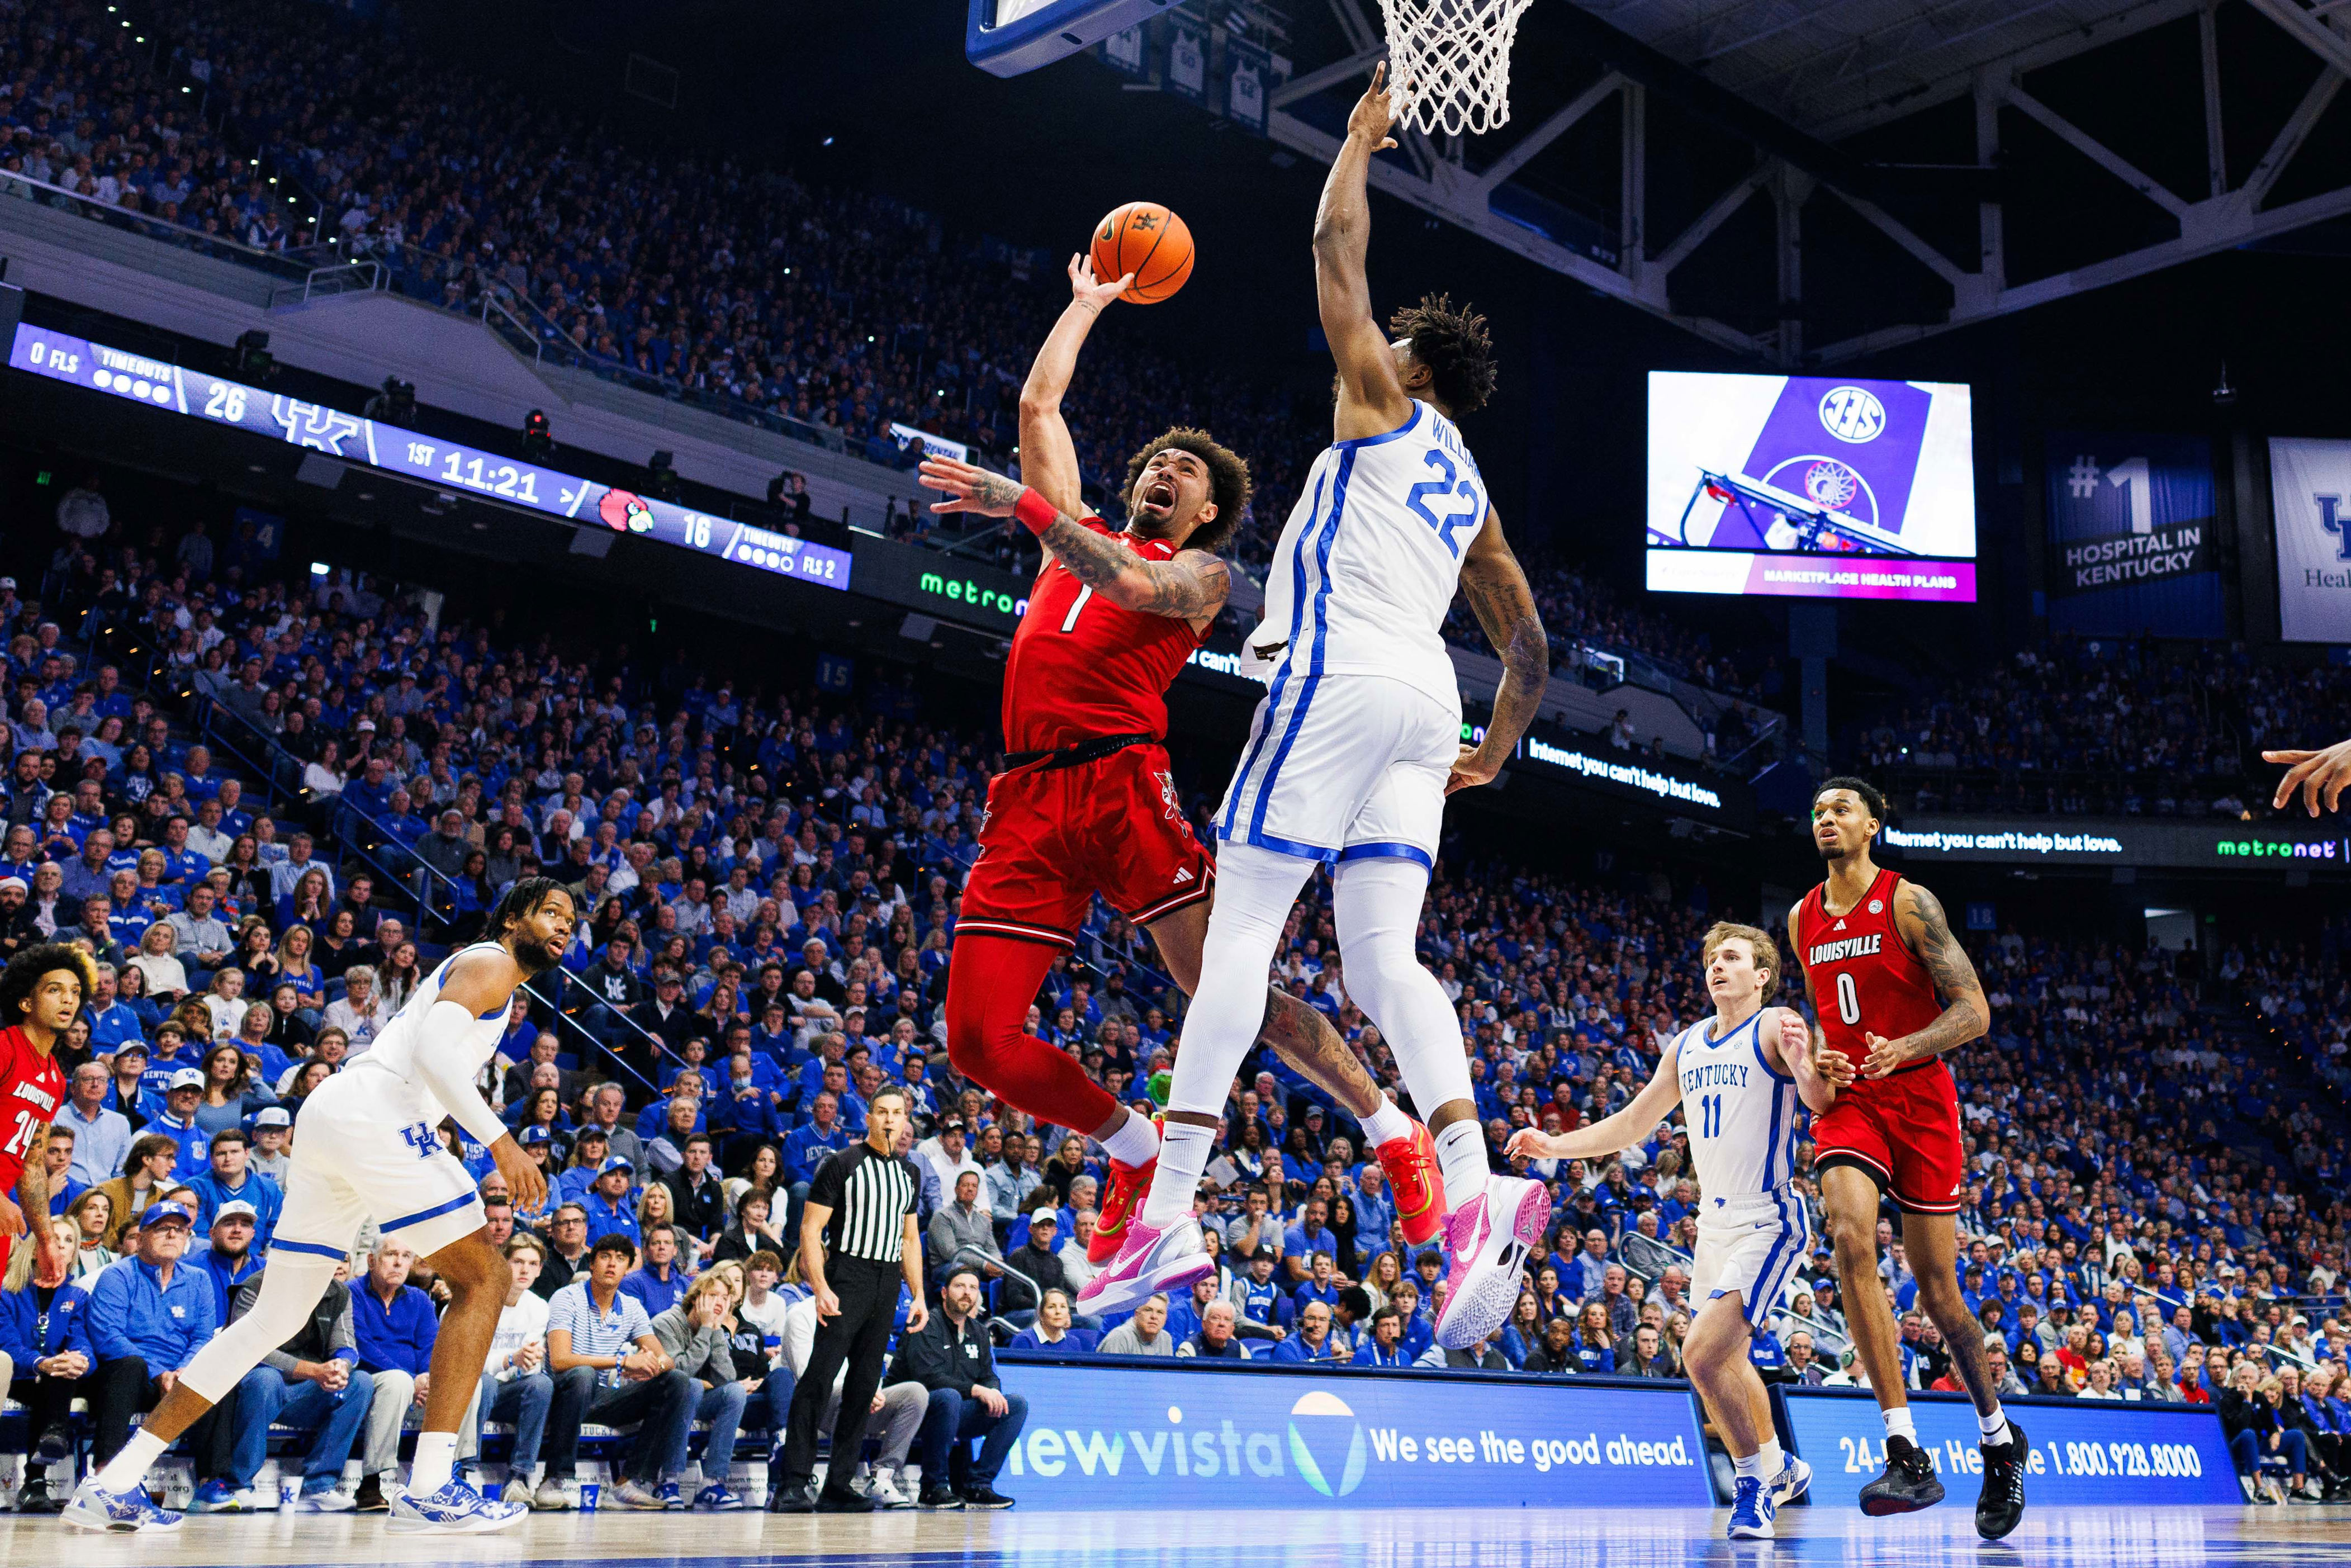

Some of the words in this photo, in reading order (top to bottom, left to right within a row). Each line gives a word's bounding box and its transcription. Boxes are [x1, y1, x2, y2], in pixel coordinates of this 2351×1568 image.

[31, 342, 44, 364] 0
[49, 349, 78, 374] FLS
[102, 349, 170, 382] TIMEOUTS
[205, 381, 247, 423] 26
[407, 442, 435, 467] 1ST
[441, 451, 539, 504] 11:21
[1406, 449, 1479, 560] 22
[2068, 454, 2151, 534] #1
[683, 513, 710, 548] 16
[743, 527, 795, 553] TIMEOUTS
[2066, 533, 2173, 567] HOSPITAL
[2177, 527, 2201, 548] IN
[802, 555, 823, 576] FLS
[824, 560, 836, 579] 2
[1764, 570, 1858, 585] MARKETPLACE
[1860, 573, 1911, 587] HEALTH
[1913, 575, 1956, 589] PLANS
[2076, 551, 2194, 587] KENTUCKY
[1529, 737, 1582, 770] Internet
[1582, 757, 1608, 776] you
[1609, 764, 1641, 786] can't
[1641, 768, 1669, 797] help
[1669, 776, 1692, 800] but
[1691, 783, 1721, 808] love.
[1885, 826, 1942, 847] Internet
[1941, 833, 1974, 851] you
[1975, 832, 2016, 850] can't
[2016, 832, 2053, 854] help
[2054, 833, 2084, 851] but
[2083, 833, 2122, 852] love.
[2217, 839, 2336, 858] metronet
[1809, 934, 1881, 966] LOUISVILLE
[1836, 973, 1861, 1026] 0
[12, 1080, 55, 1113] LOUISVILLE
[1680, 1064, 1748, 1096] KENTUCKY
[1701, 1093, 1722, 1139] 11
[4, 1110, 40, 1160] 24
[398, 1120, 445, 1160] UK
[1128, 1406, 1285, 1478] vista
[1369, 1428, 1418, 1462] We
[1425, 1434, 1475, 1463] see
[1480, 1430, 1525, 1464] the
[1531, 1433, 1601, 1472] good
[1605, 1433, 1694, 1466] ahead.
[2047, 1441, 2202, 1477] 1.800.928.8000
